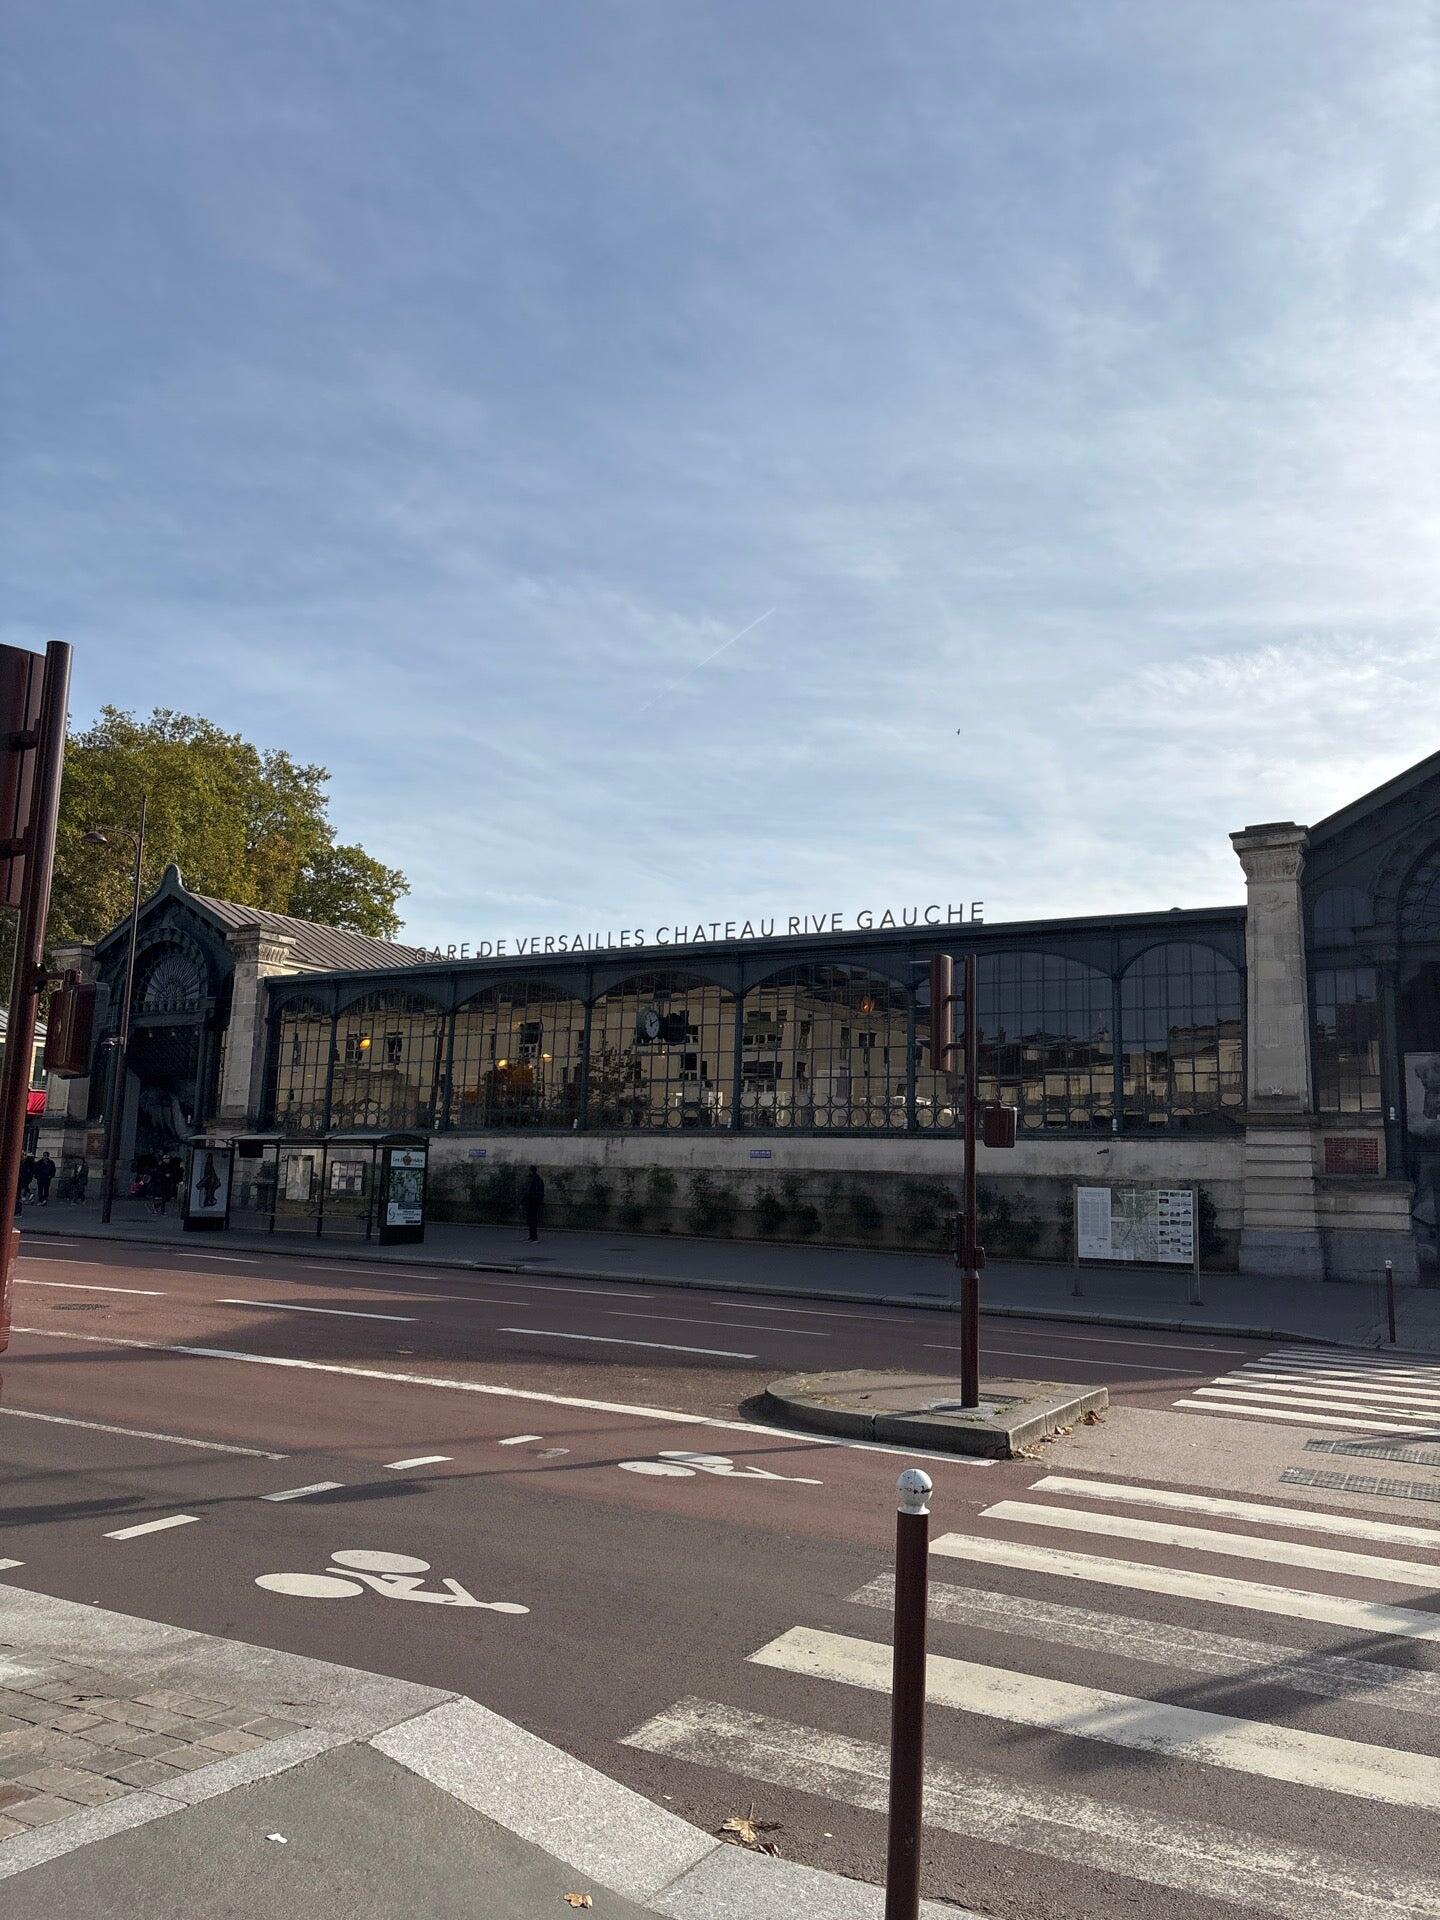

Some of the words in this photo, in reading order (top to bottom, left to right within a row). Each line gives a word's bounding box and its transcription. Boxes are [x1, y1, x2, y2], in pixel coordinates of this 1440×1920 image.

[416, 943, 470, 961] GARE
[481, 940, 507, 958] DE
[516, 928, 645, 955] VERSAILLES
[656, 918, 774, 945] CHATEAU
[789, 913, 843, 934] RIVE
[857, 902, 984, 930] GAUCHE
